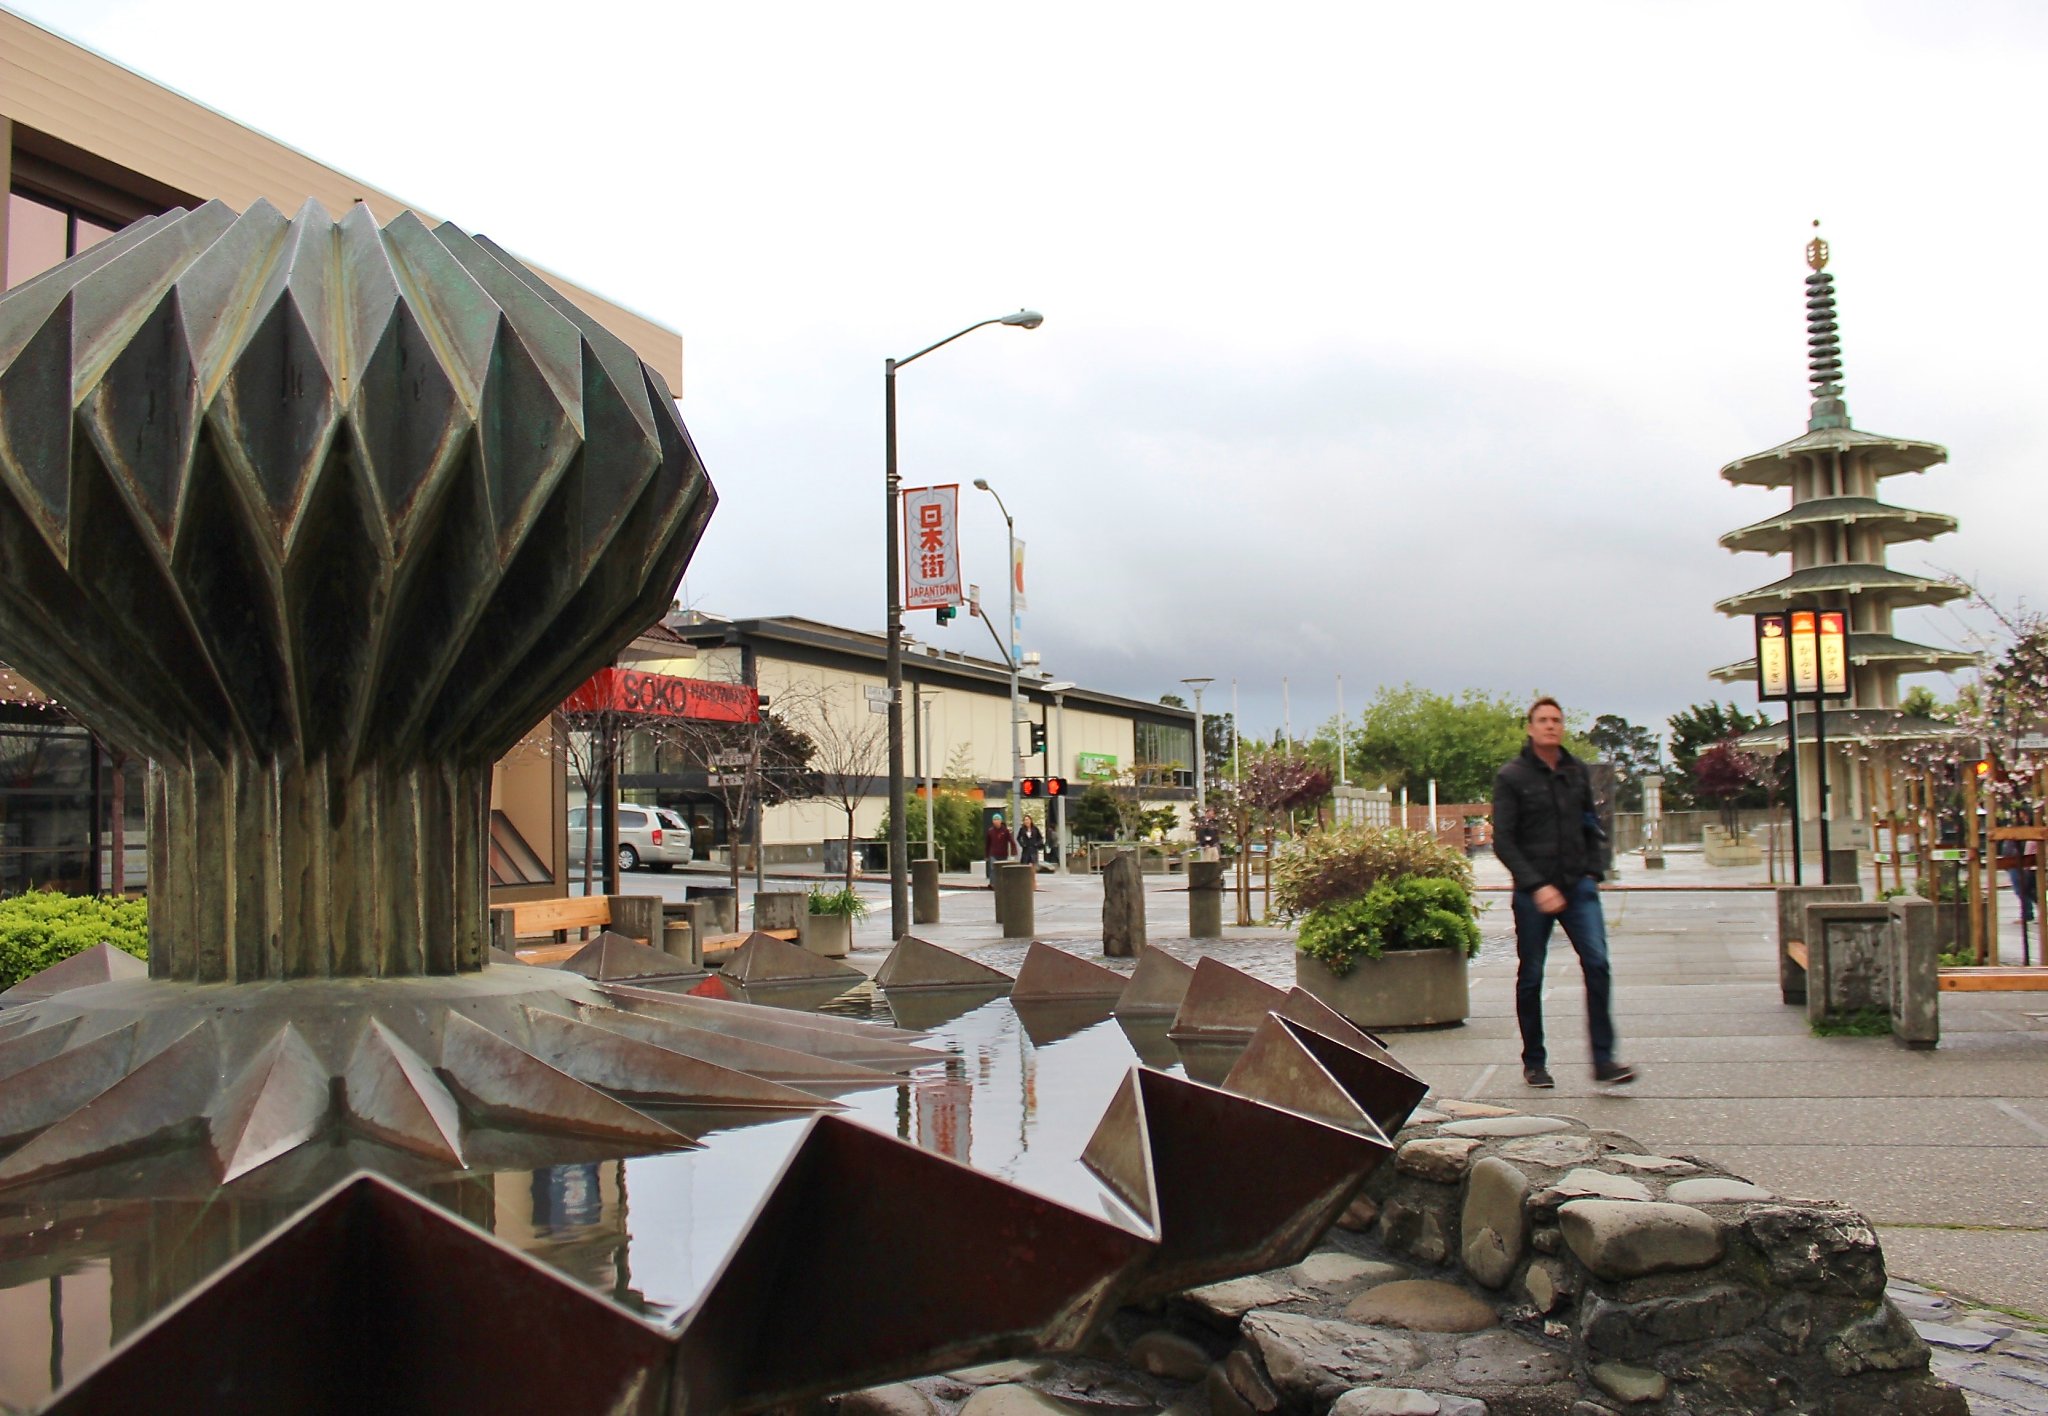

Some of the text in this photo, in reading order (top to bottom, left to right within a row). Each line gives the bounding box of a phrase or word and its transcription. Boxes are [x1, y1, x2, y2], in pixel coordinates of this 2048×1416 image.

[920, 504, 944, 579] 日本街
[909, 584, 959, 599] JAPANTOWN
[623, 673, 747, 715] SOKO HARDWARE
